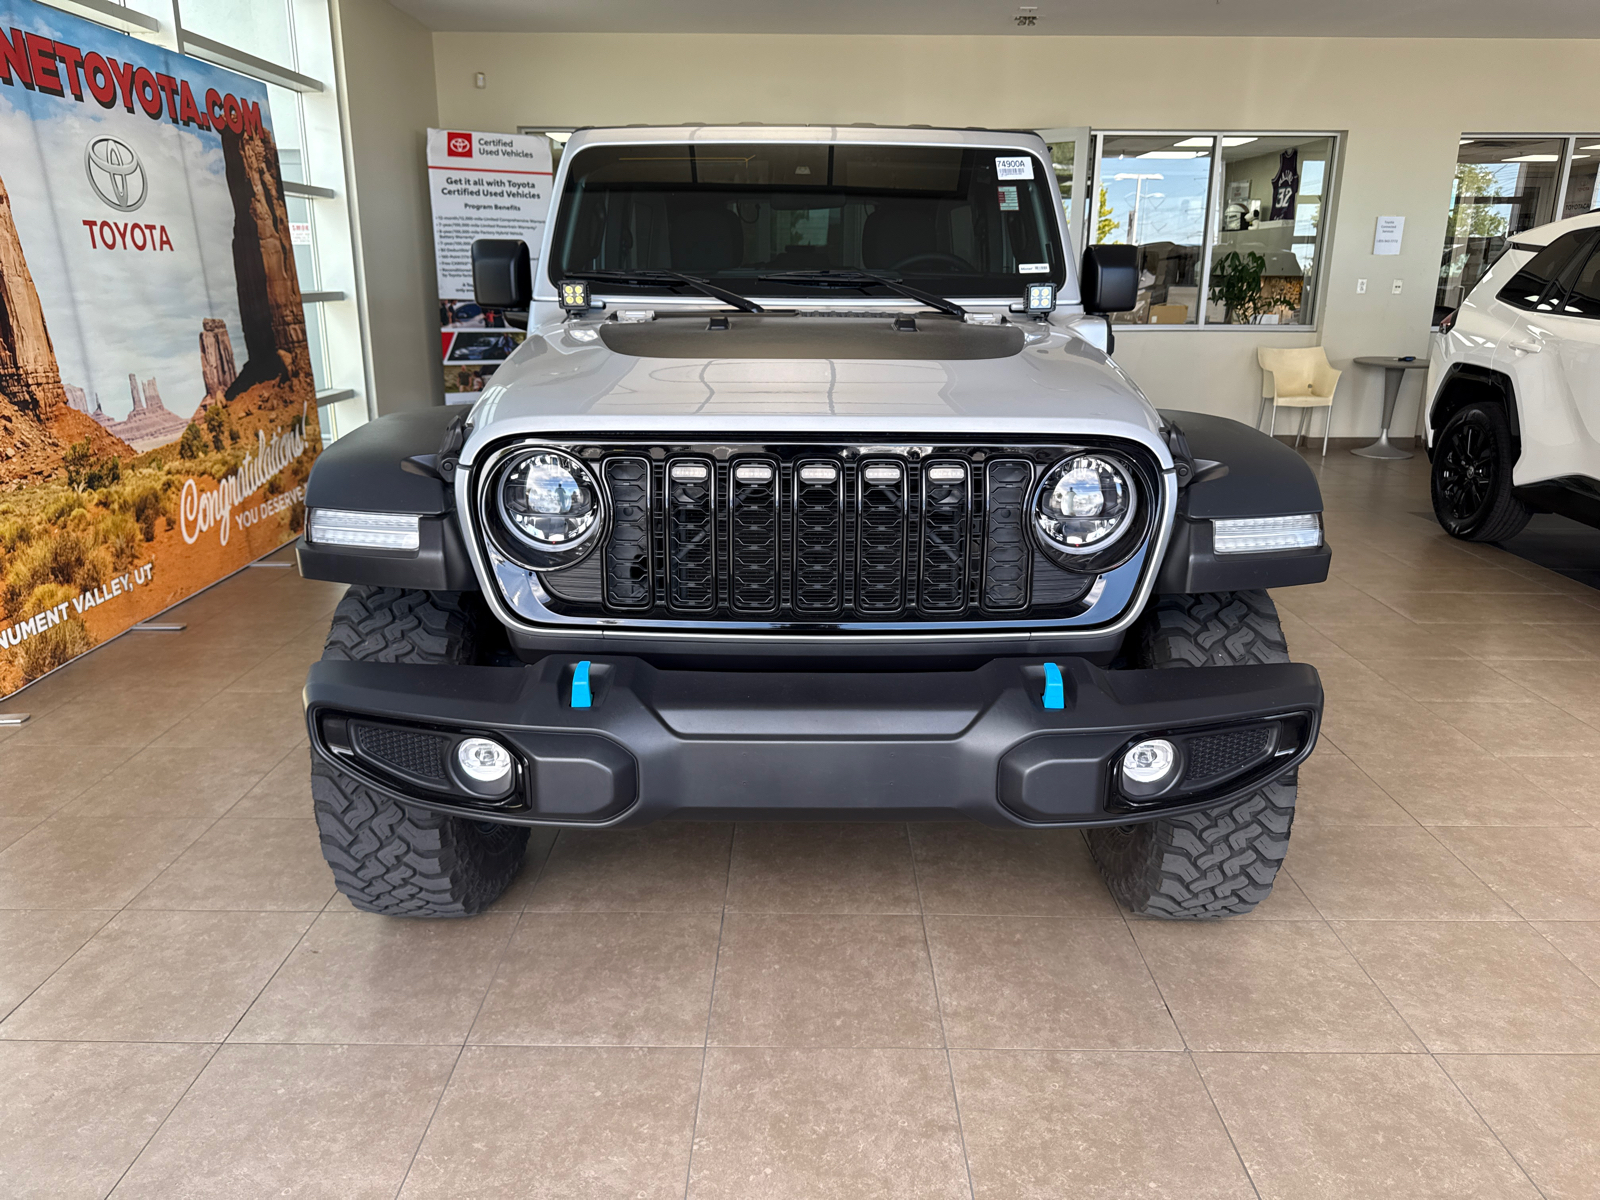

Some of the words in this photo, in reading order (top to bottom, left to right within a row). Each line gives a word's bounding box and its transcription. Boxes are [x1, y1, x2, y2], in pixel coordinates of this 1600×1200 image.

[478, 138, 513, 148] Certified
[479, 148, 499, 156] Used
[501, 149, 533, 158] Vehicles
[446, 177, 462, 186] Get
[464, 178, 471, 186] it
[473, 178, 484, 187] all
[486, 179, 505, 188] with
[507, 180, 535, 191] Toyota
[441, 187, 480, 197] Certified
[482, 189, 504, 198] Used
[506, 190, 541, 199] Vehicles
[1275, 188, 1292, 207] 32
[464, 203, 493, 211] Program
[494, 203, 521, 211] Benefits
[82, 220, 174, 251] TOYOTA
[180, 400, 309, 546] Congratulations!
[235, 507, 259, 531] YOU
[260, 486, 305, 519] DESERVE
[72, 573, 134, 614] VALLEY,
[133, 563, 154, 586] UT
